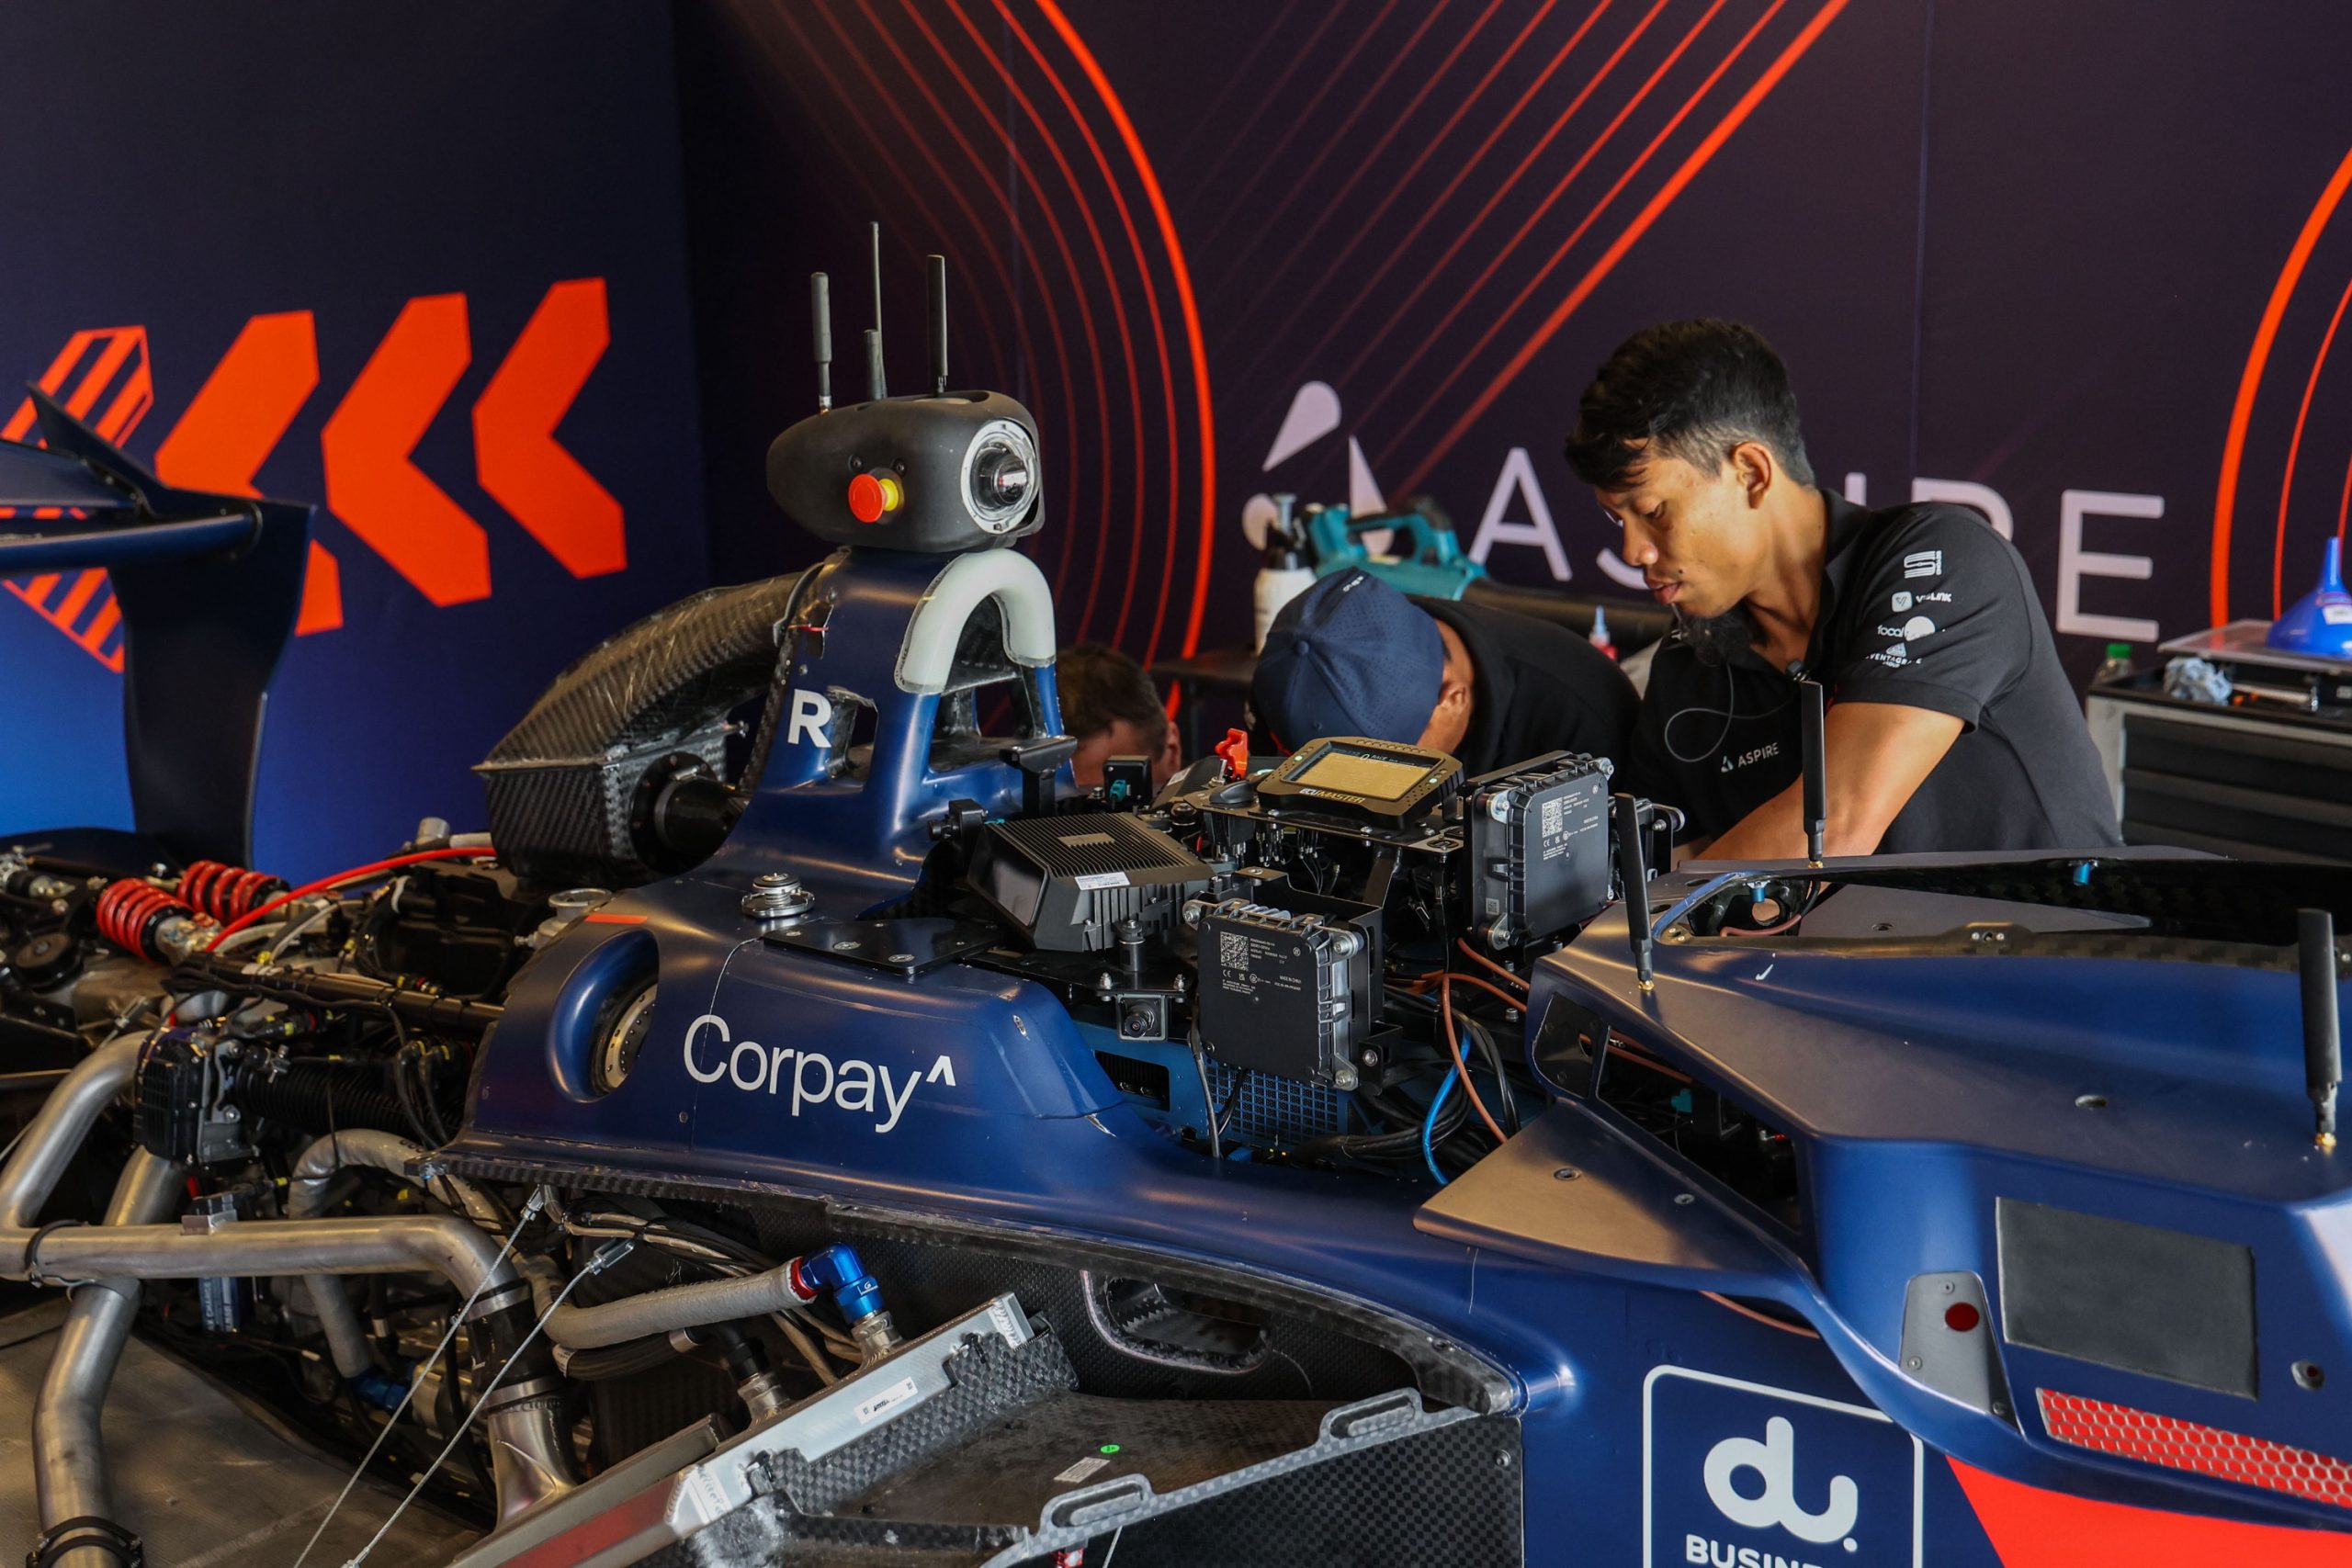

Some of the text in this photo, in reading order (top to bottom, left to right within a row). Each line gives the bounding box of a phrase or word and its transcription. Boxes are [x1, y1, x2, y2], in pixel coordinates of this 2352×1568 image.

[787, 689, 831, 749] R
[1737, 742, 1780, 768] ASPIRE
[1686, 1534, 1824, 1568] BUSI
